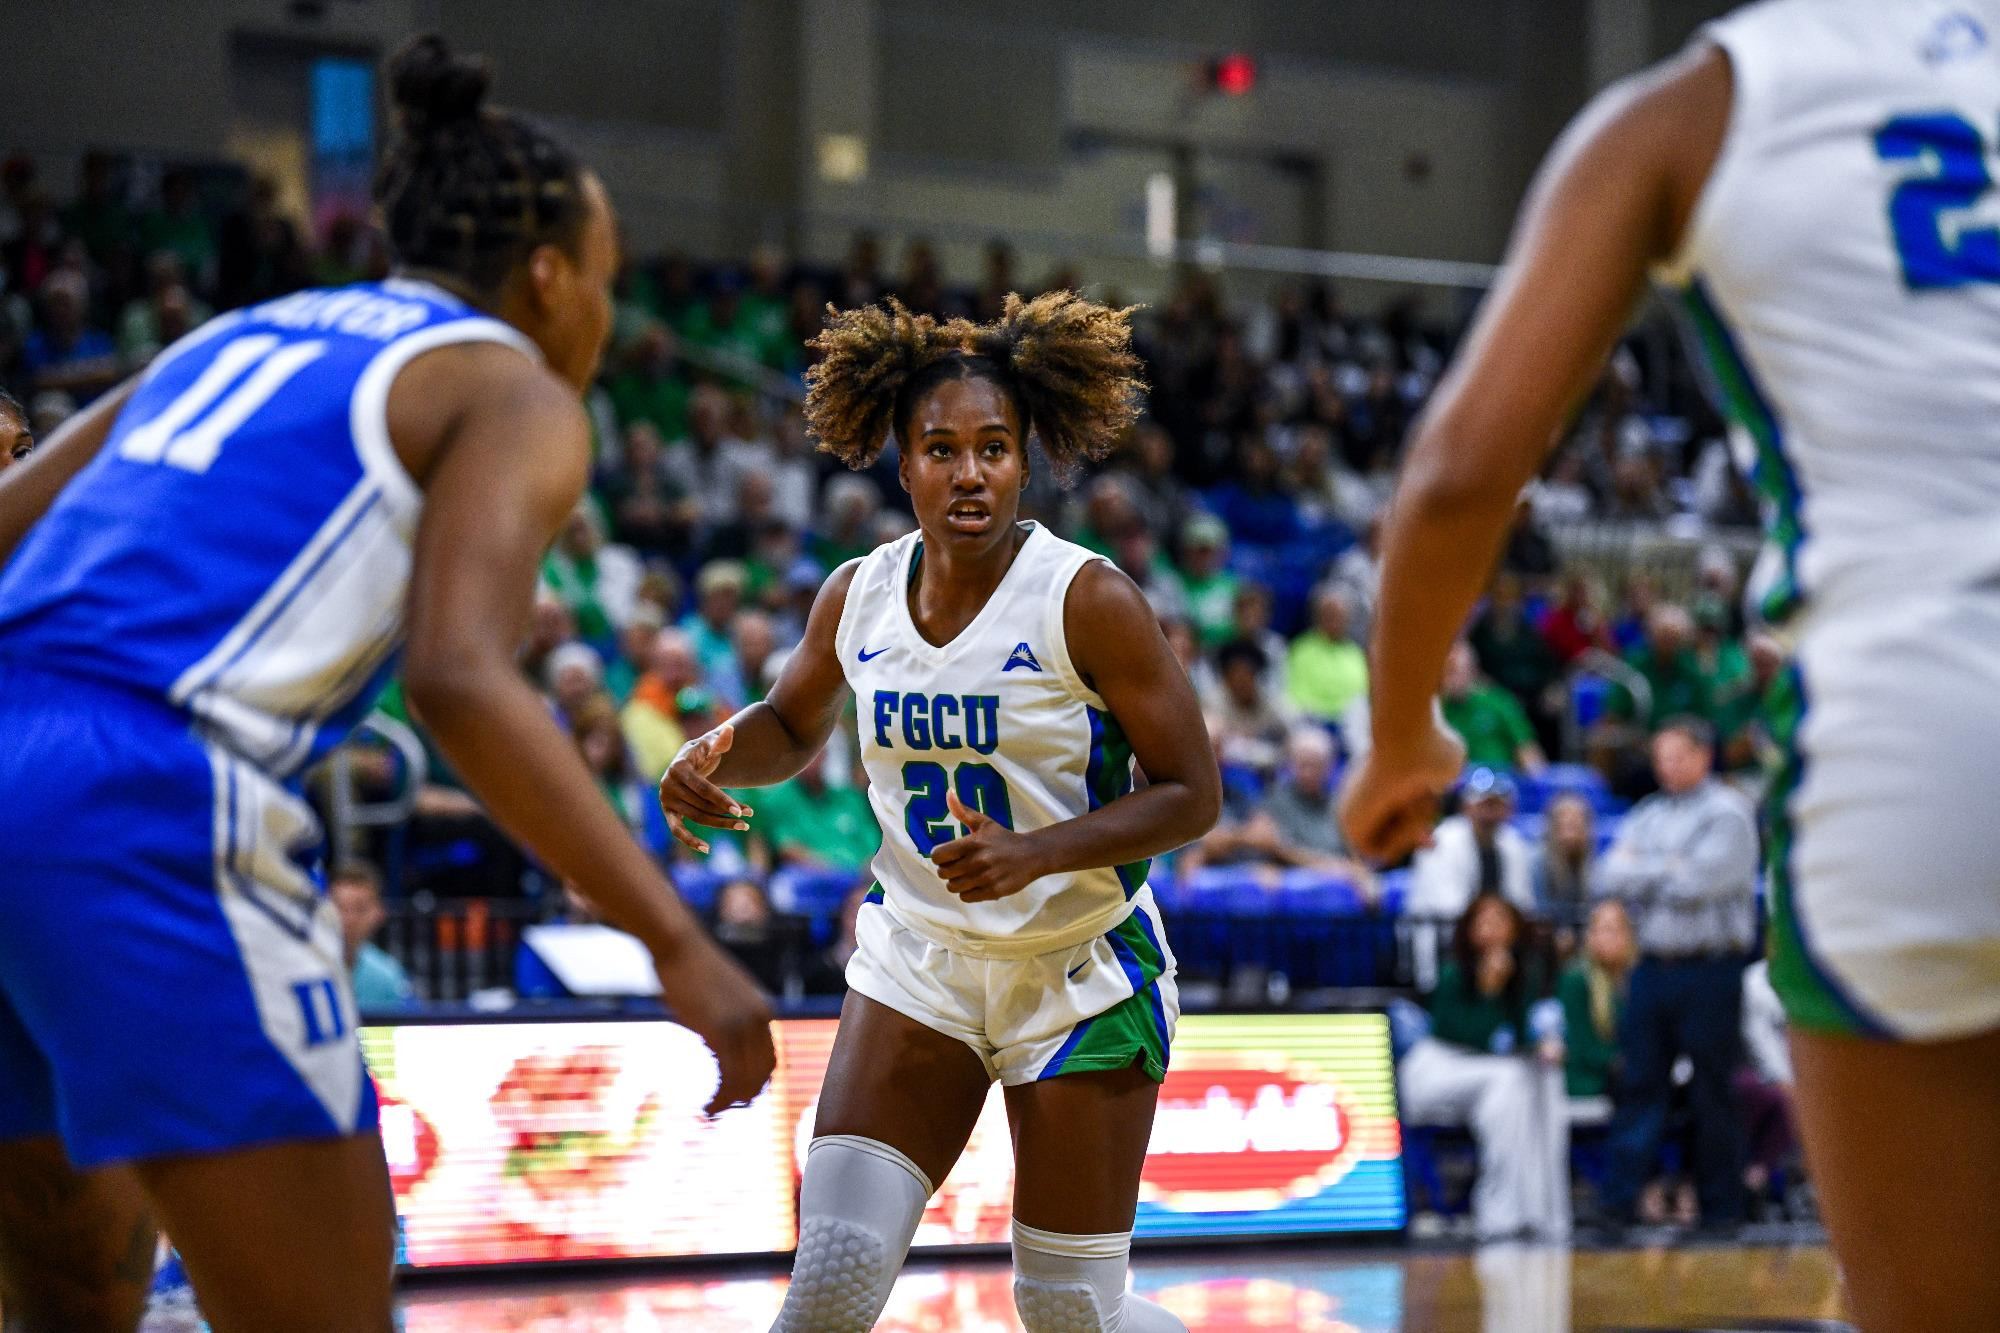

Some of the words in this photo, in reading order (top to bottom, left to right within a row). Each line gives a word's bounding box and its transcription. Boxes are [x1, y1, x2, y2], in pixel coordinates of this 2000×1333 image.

[120, 335, 326, 475] 11
[873, 690, 999, 755] FGCU
[901, 761, 1014, 858] 20
